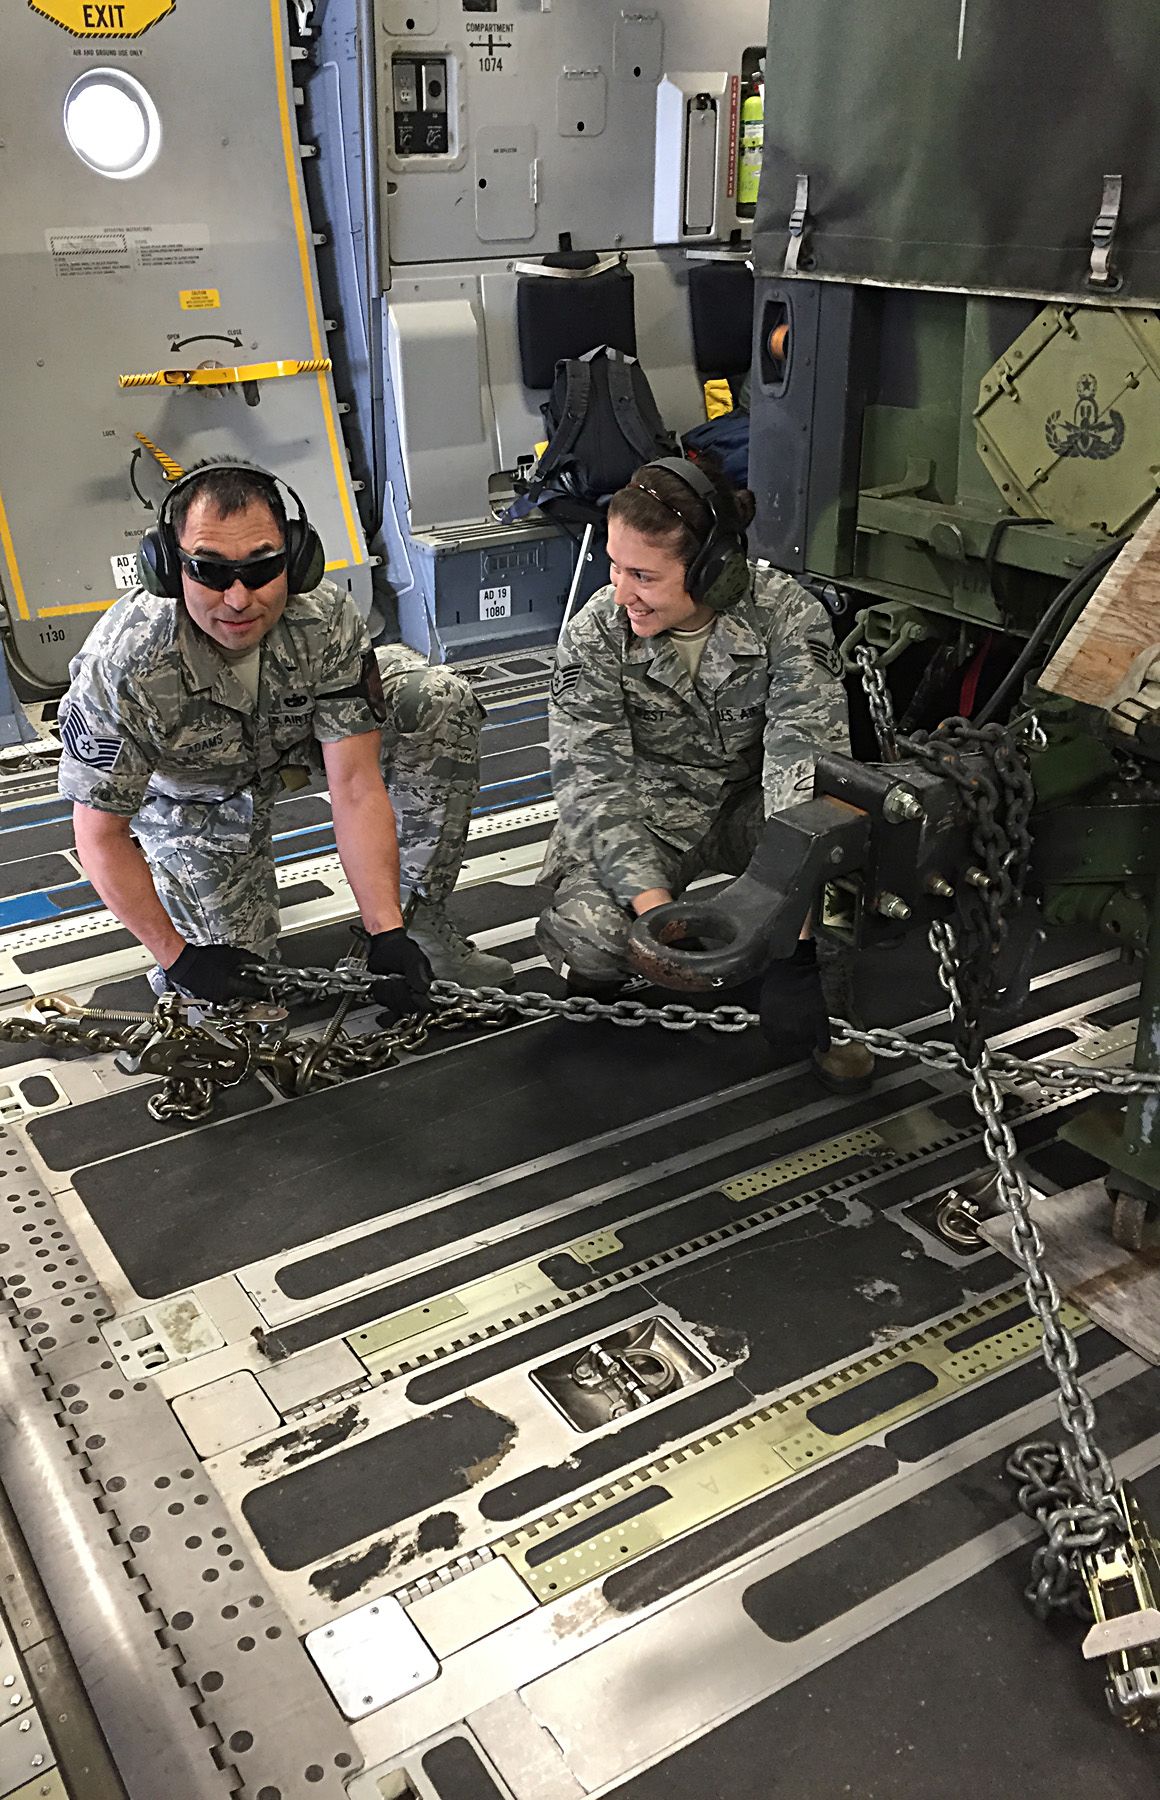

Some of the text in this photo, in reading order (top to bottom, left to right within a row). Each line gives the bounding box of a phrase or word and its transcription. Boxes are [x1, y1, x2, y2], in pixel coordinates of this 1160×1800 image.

[82, 4, 125, 28] EXIT
[465, 22, 514, 32] COMPARTMENT
[479, 57, 503, 72] 1074
[117, 556, 130, 567] AD
[122, 574, 142, 587] 112
[483, 588, 507, 600] AD 19
[485, 605, 506, 618] 1080
[39, 629, 66, 644] 1130
[187, 732, 223, 755] ADAMS
